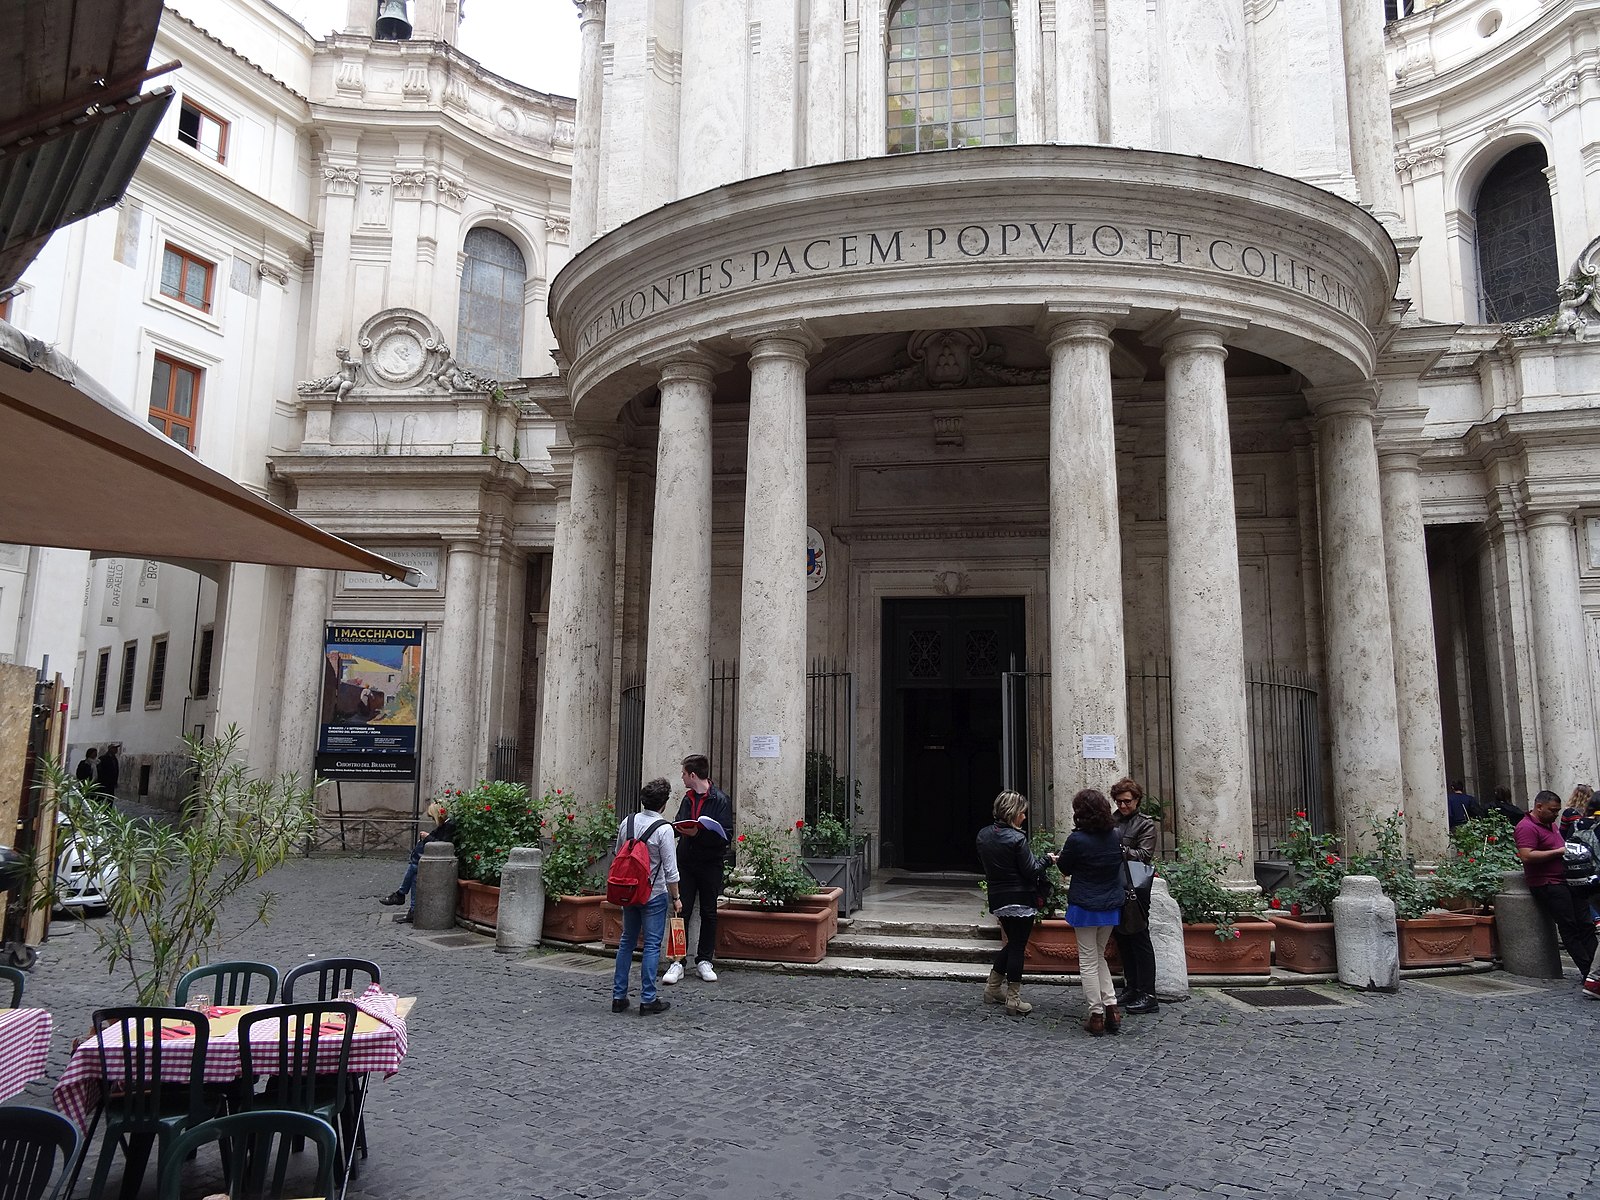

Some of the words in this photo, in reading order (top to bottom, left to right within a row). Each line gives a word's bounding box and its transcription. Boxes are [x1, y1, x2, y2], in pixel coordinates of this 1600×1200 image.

[610, 258, 734, 332] MONTES
[751, 230, 905, 283] PACEM
[924, 223, 1125, 260] POPVLO
[1144, 228, 1192, 265] ET
[1208, 239, 1330, 303] COLLES
[111, 564, 124, 608] RAFFAELLO
[335, 629, 338, 637] I
[341, 628, 415, 639] MACCHIAIOLI
